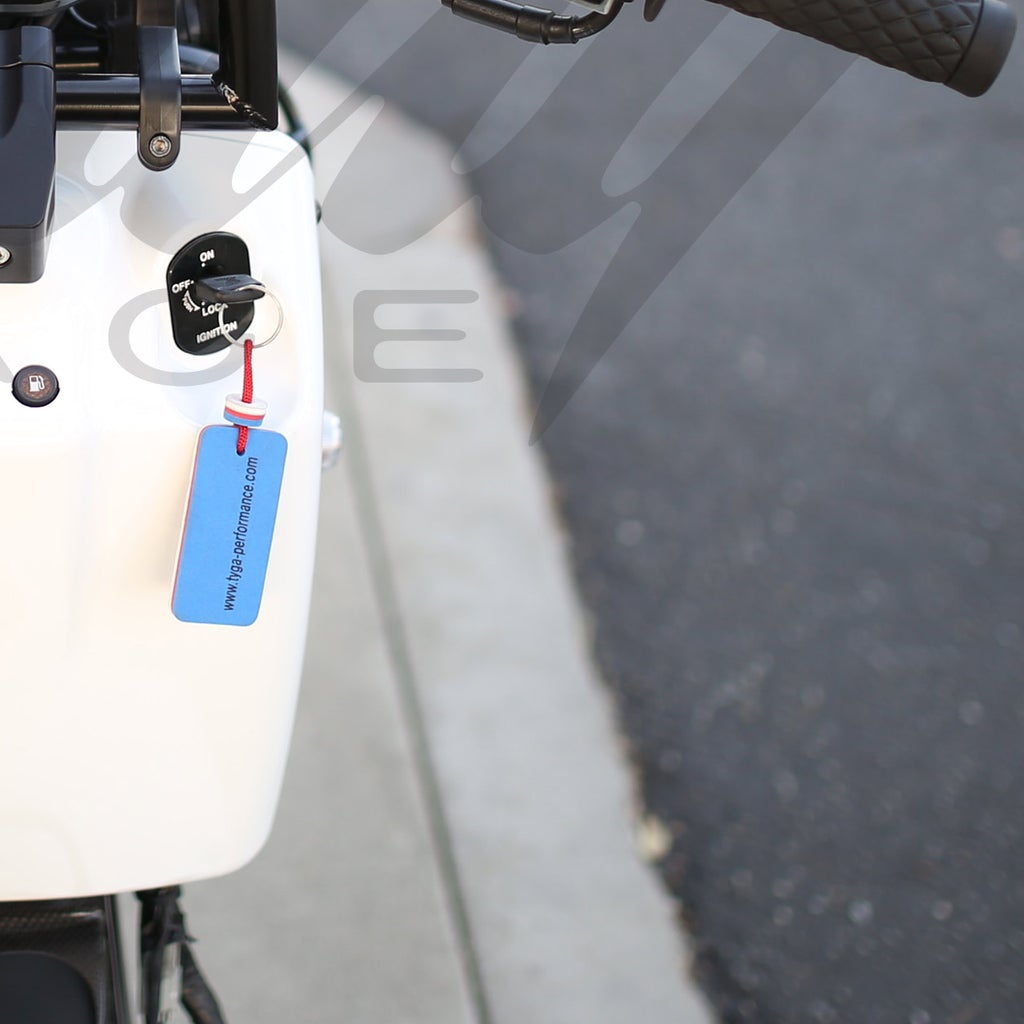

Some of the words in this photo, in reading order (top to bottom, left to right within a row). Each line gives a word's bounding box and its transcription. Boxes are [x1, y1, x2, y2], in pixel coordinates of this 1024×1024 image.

[199, 249, 215, 262] ON
[171, 279, 191, 294] OFF
[201, 302, 228, 317] LOC
[196, 321, 238, 344] IGNITON
[224, 456, 259, 611] www.tyga-performance.com
